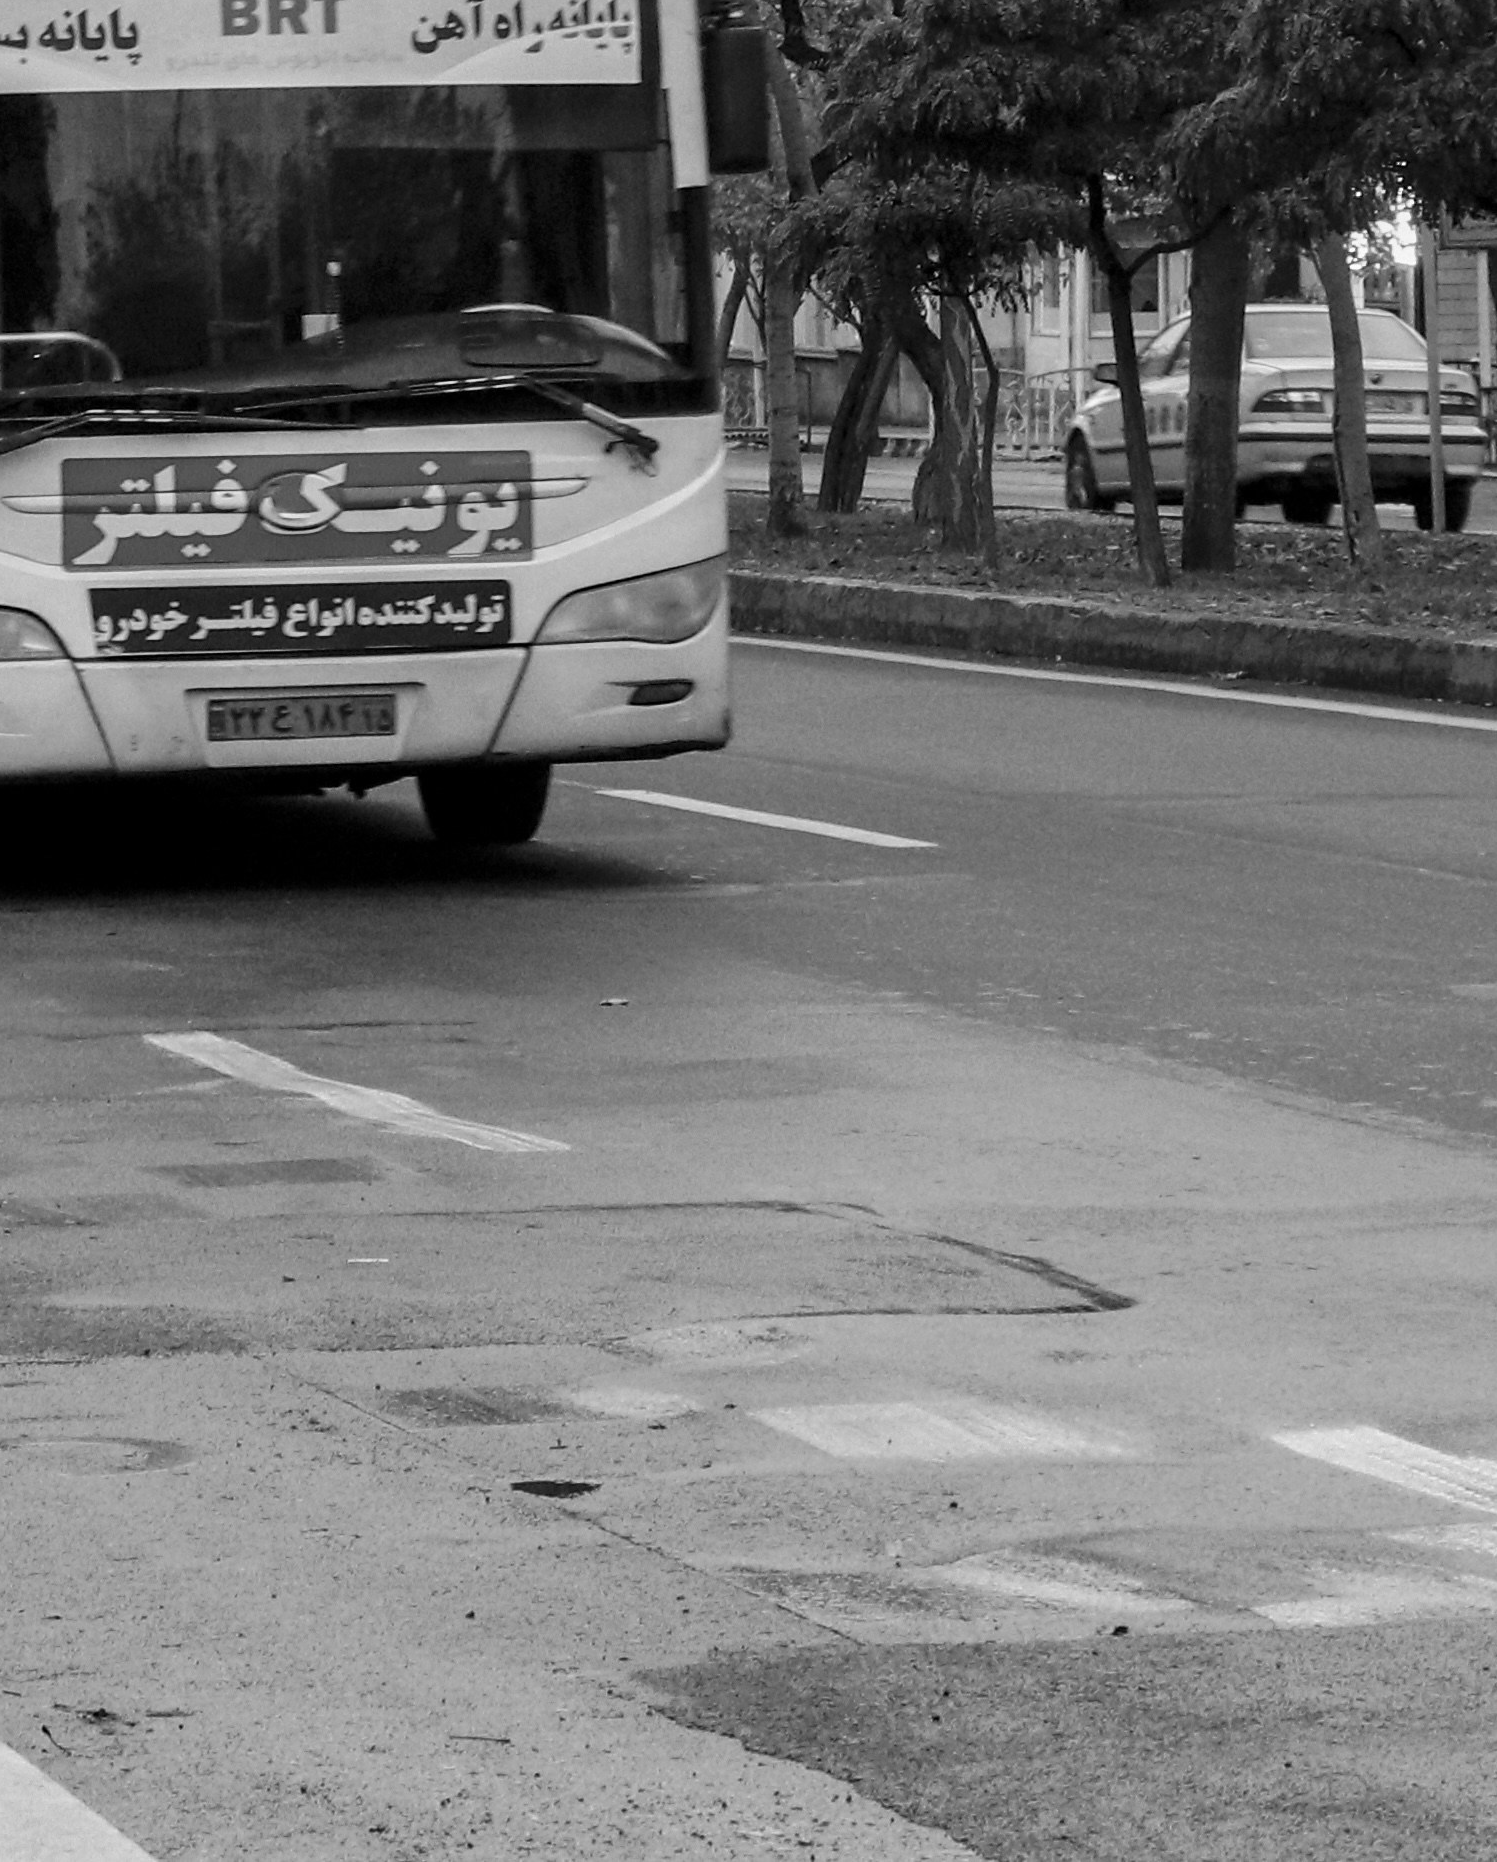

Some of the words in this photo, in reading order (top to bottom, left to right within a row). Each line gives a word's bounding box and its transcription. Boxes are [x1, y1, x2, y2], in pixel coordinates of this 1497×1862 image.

[39, 8, 142, 66] پایانه
[71, 459, 248, 565] فیلتر
[258, 460, 522, 557] یونیک
[92, 601, 189, 641] خودرو
[189, 596, 279, 640] فیلتر
[281, 596, 356, 637] انواع
